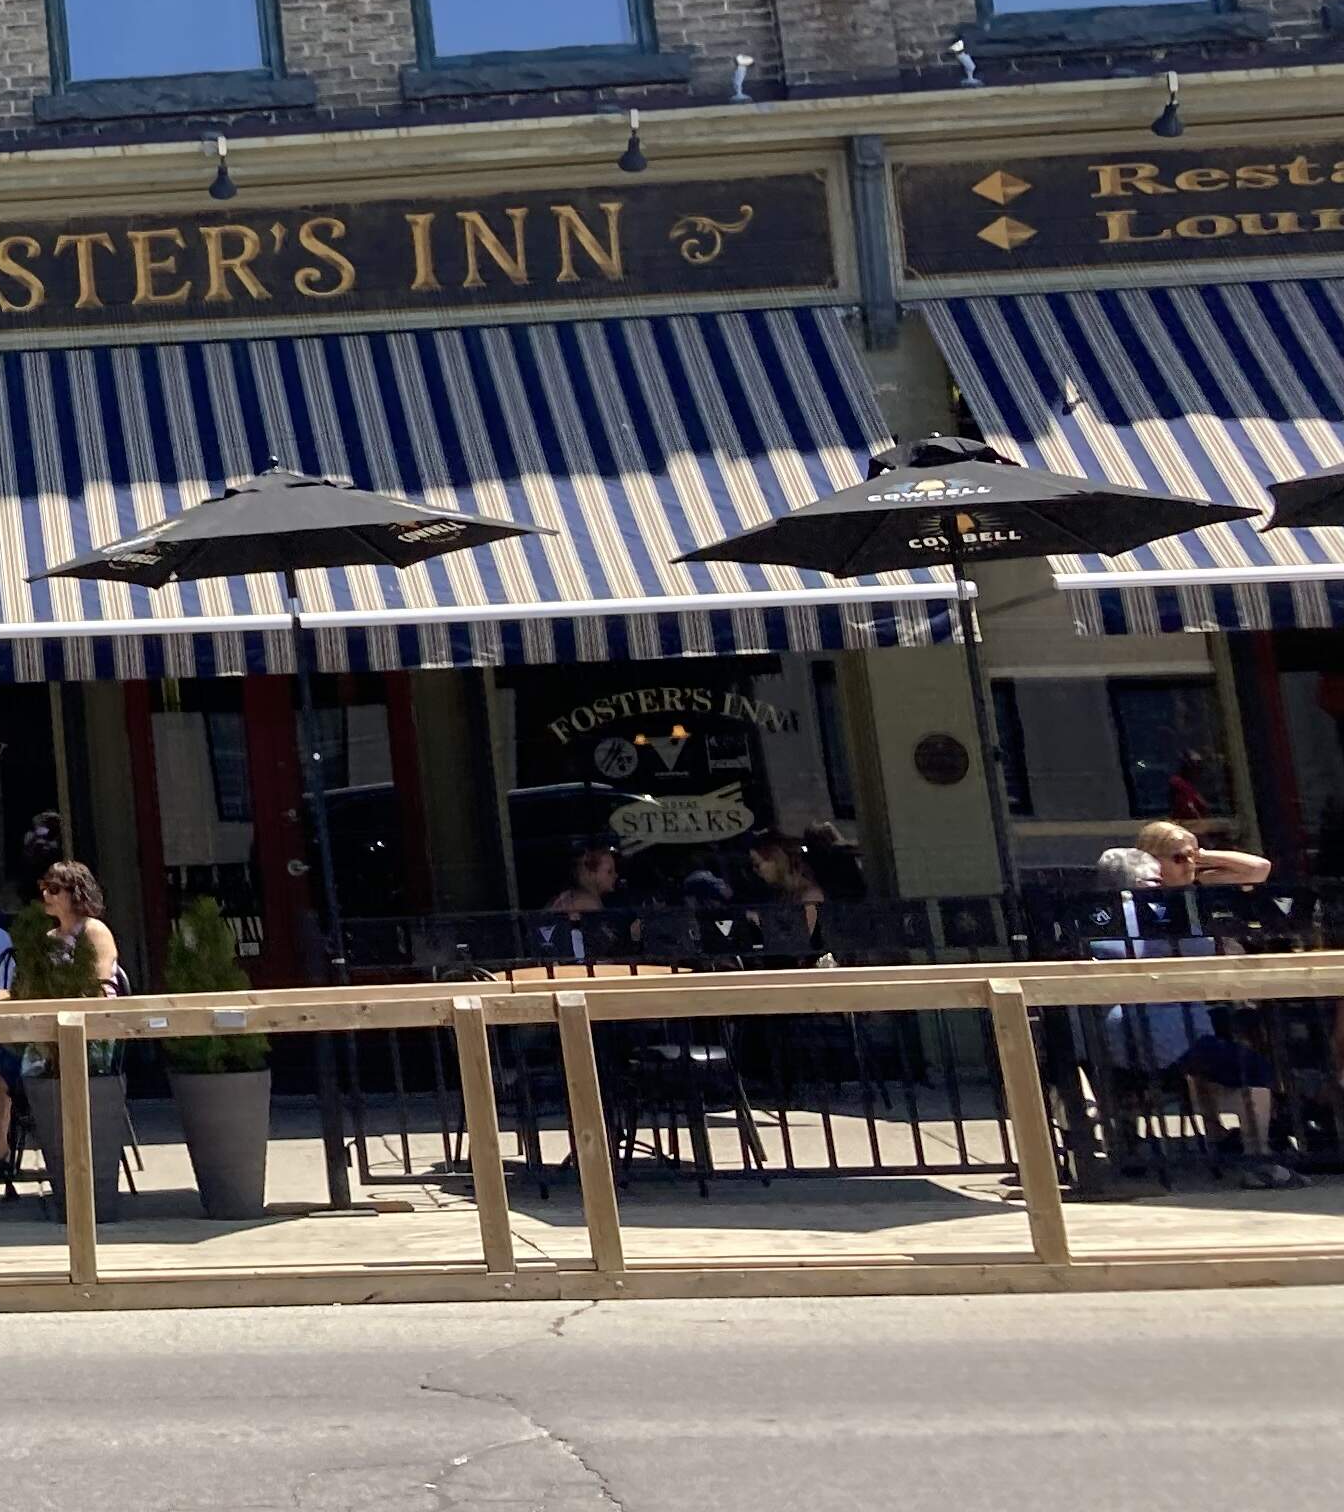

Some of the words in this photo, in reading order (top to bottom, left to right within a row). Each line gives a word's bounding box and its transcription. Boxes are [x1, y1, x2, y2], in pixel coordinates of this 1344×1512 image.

[403, 201, 626, 292] INN
[548, 687, 713, 745] FOSTER'S
[720, 692, 786, 732] INN
[621, 809, 744, 833] STEAKS
